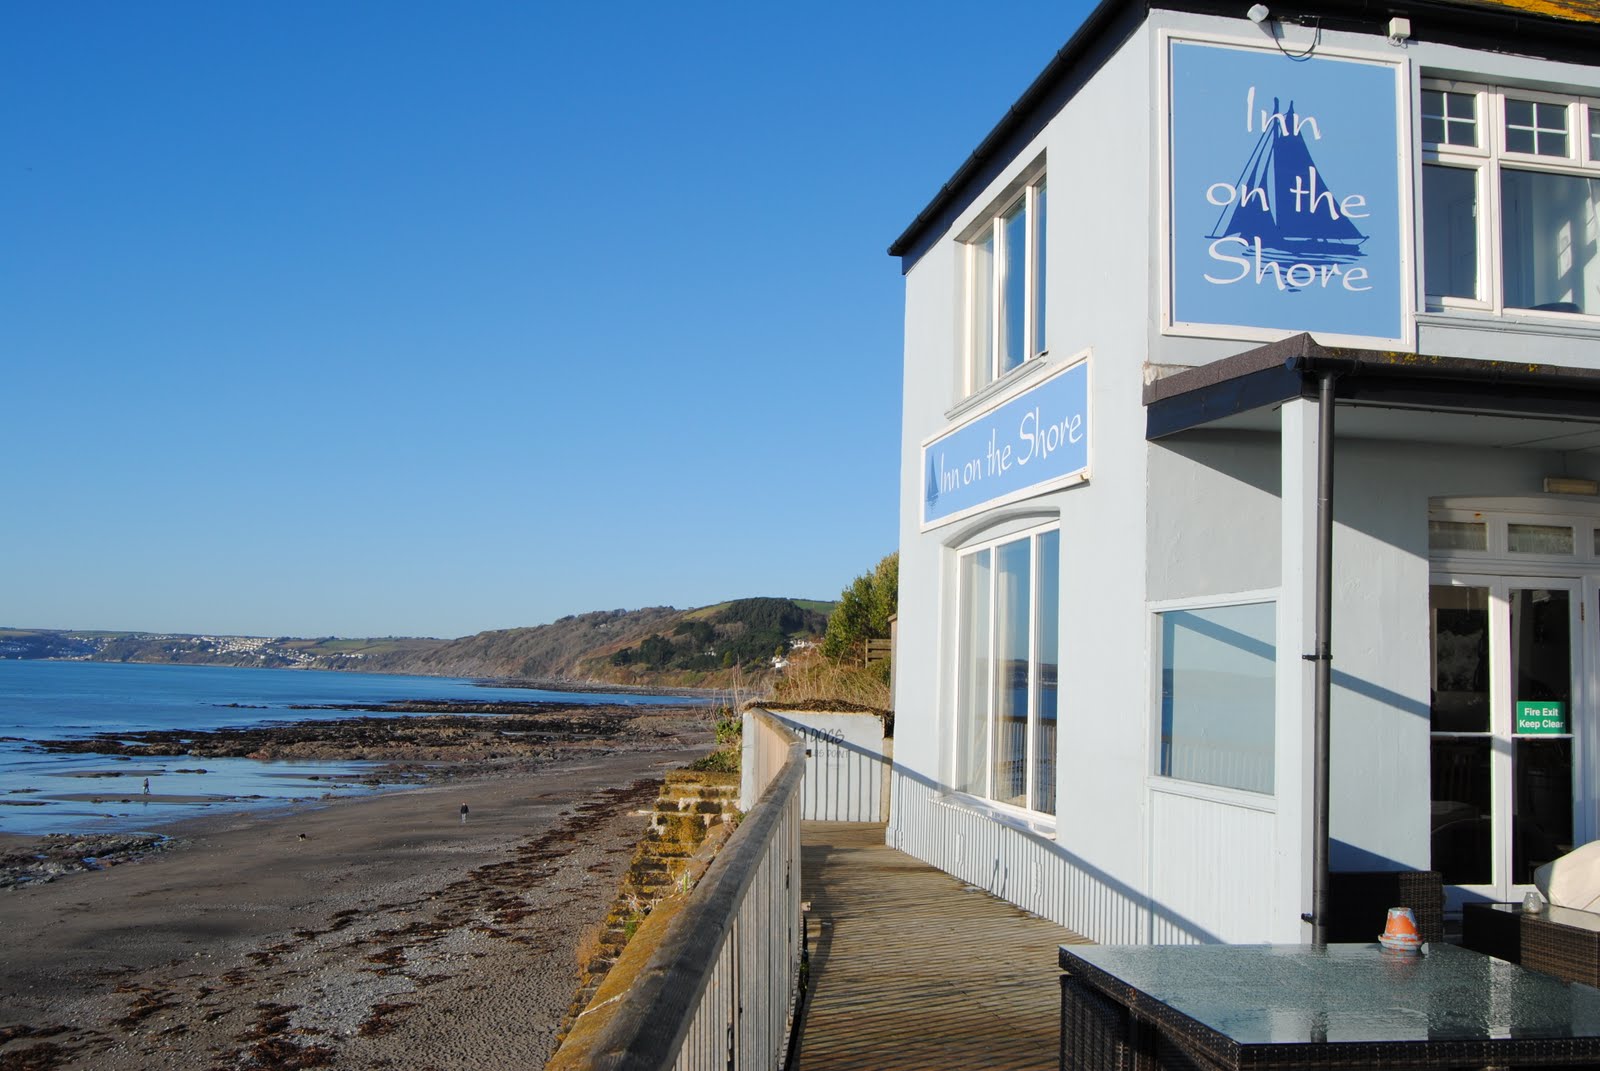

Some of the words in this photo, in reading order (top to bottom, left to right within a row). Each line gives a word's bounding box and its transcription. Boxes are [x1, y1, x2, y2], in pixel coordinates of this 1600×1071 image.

[1246, 86, 1321, 140] Inn
[1206, 182, 1270, 212] on
[1289, 166, 1370, 221] the
[1203, 235, 1373, 292] Shore
[940, 452, 960, 494] Inn
[963, 458, 982, 485] on
[987, 428, 1012, 477] the
[1017, 406, 1083, 466] Shore
[811, 727, 845, 744] DOGS
[1519, 719, 1540, 730] Keep
[1542, 719, 1564, 728] Clear
[1524, 707, 1541, 717] Fire
[1542, 707, 1559, 717] Exit
